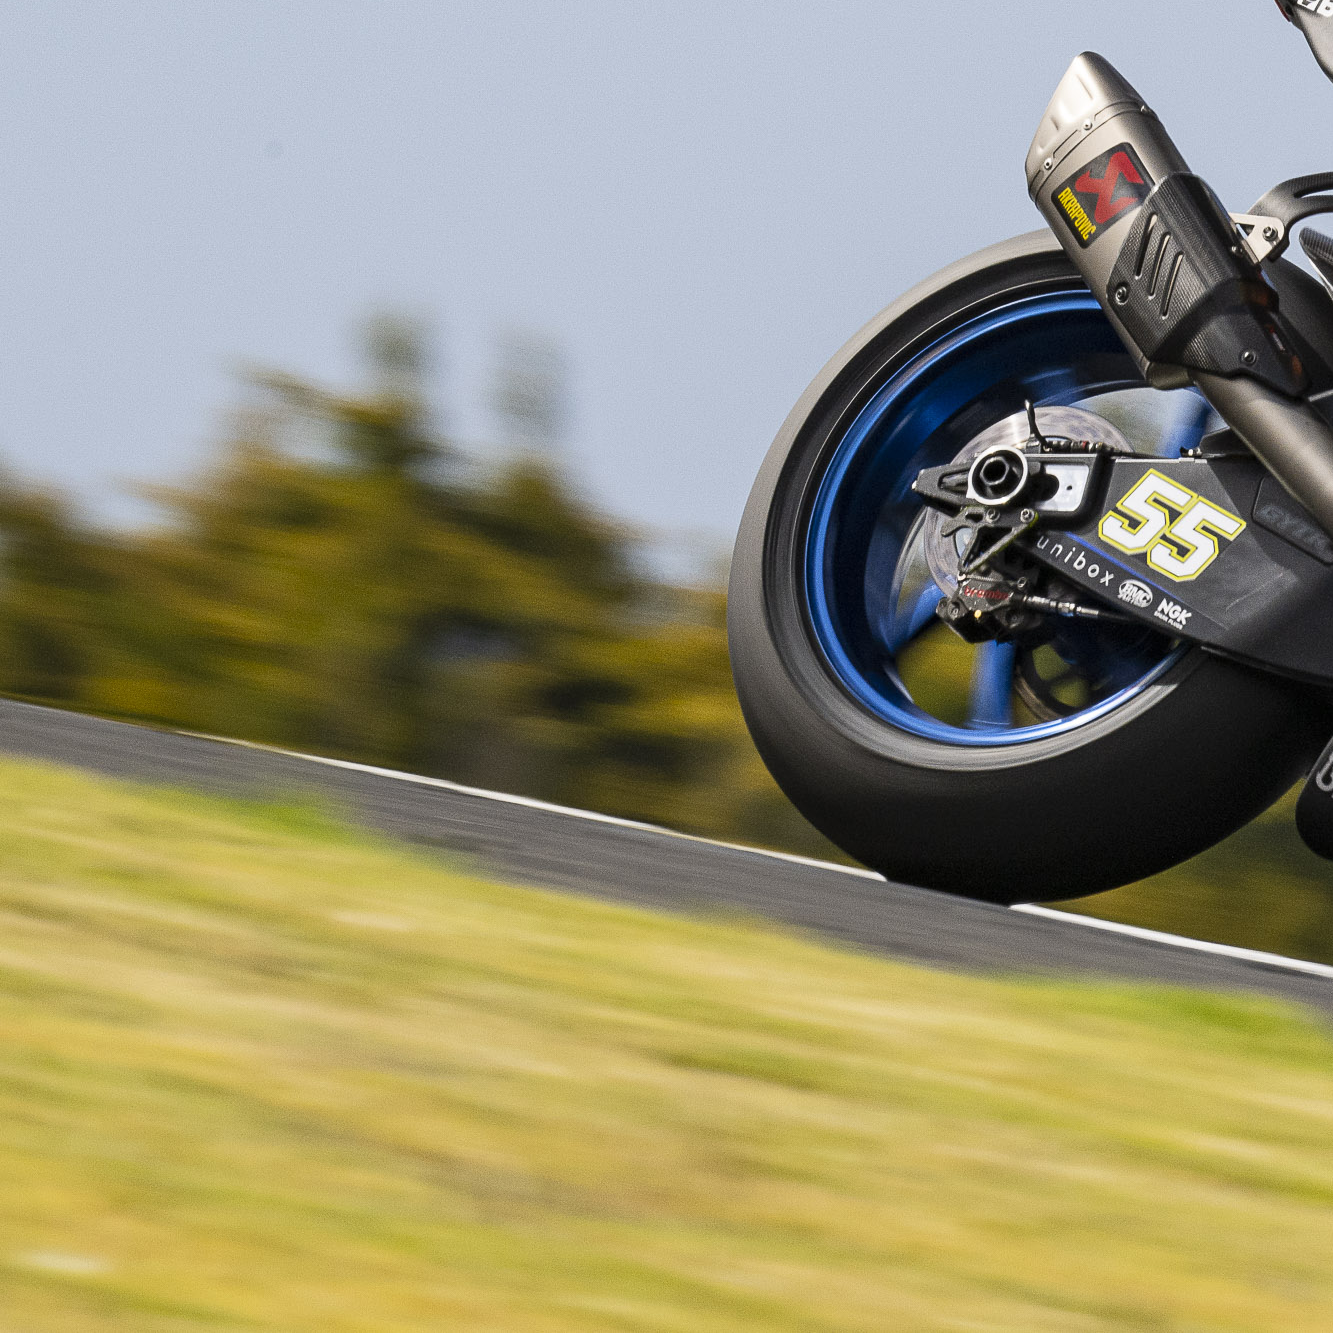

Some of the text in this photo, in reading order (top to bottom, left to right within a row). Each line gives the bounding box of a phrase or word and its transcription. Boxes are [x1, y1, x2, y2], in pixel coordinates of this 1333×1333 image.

[1098, 468, 1247, 582] 55
[1036, 535, 1114, 587] unibox
[1156, 598, 1192, 625] NGK
